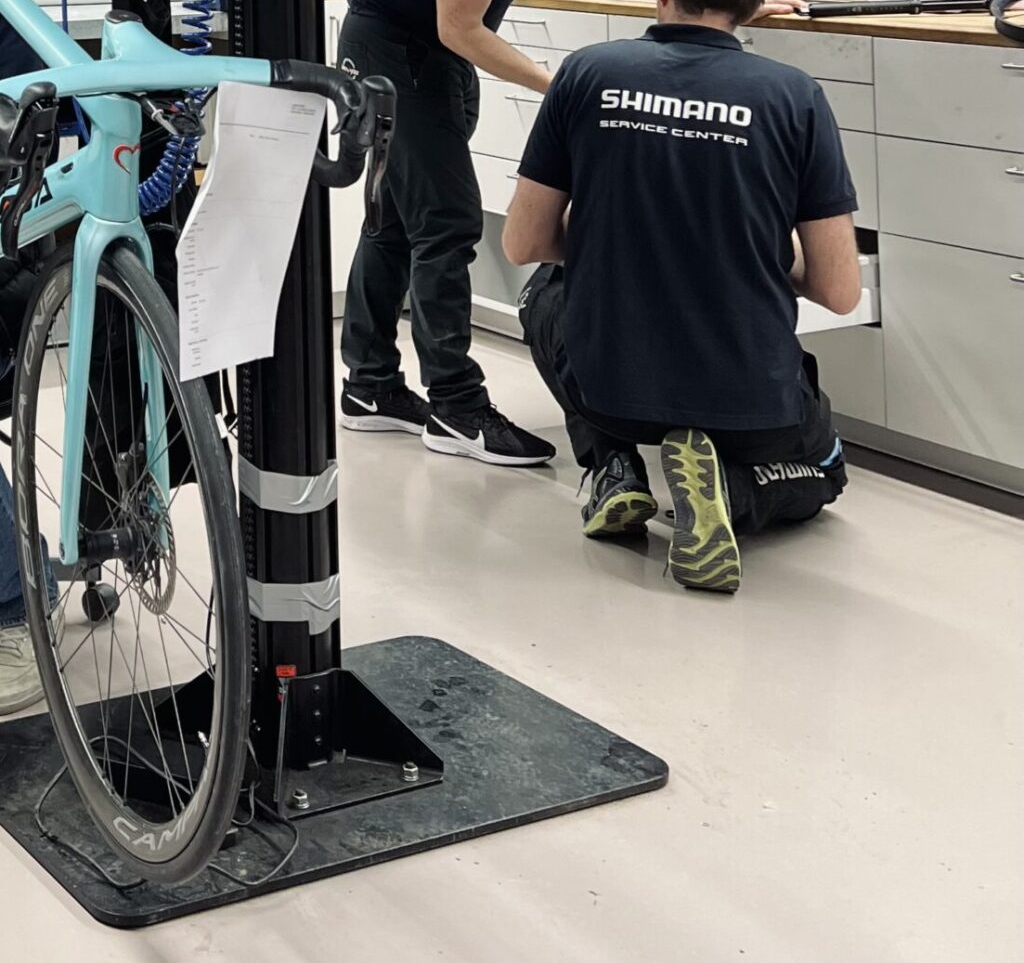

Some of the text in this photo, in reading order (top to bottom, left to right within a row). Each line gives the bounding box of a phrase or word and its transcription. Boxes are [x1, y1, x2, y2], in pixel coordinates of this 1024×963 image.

[600, 88, 753, 127] SHIMANO
[599, 120, 749, 146] SERVICE CENTER
